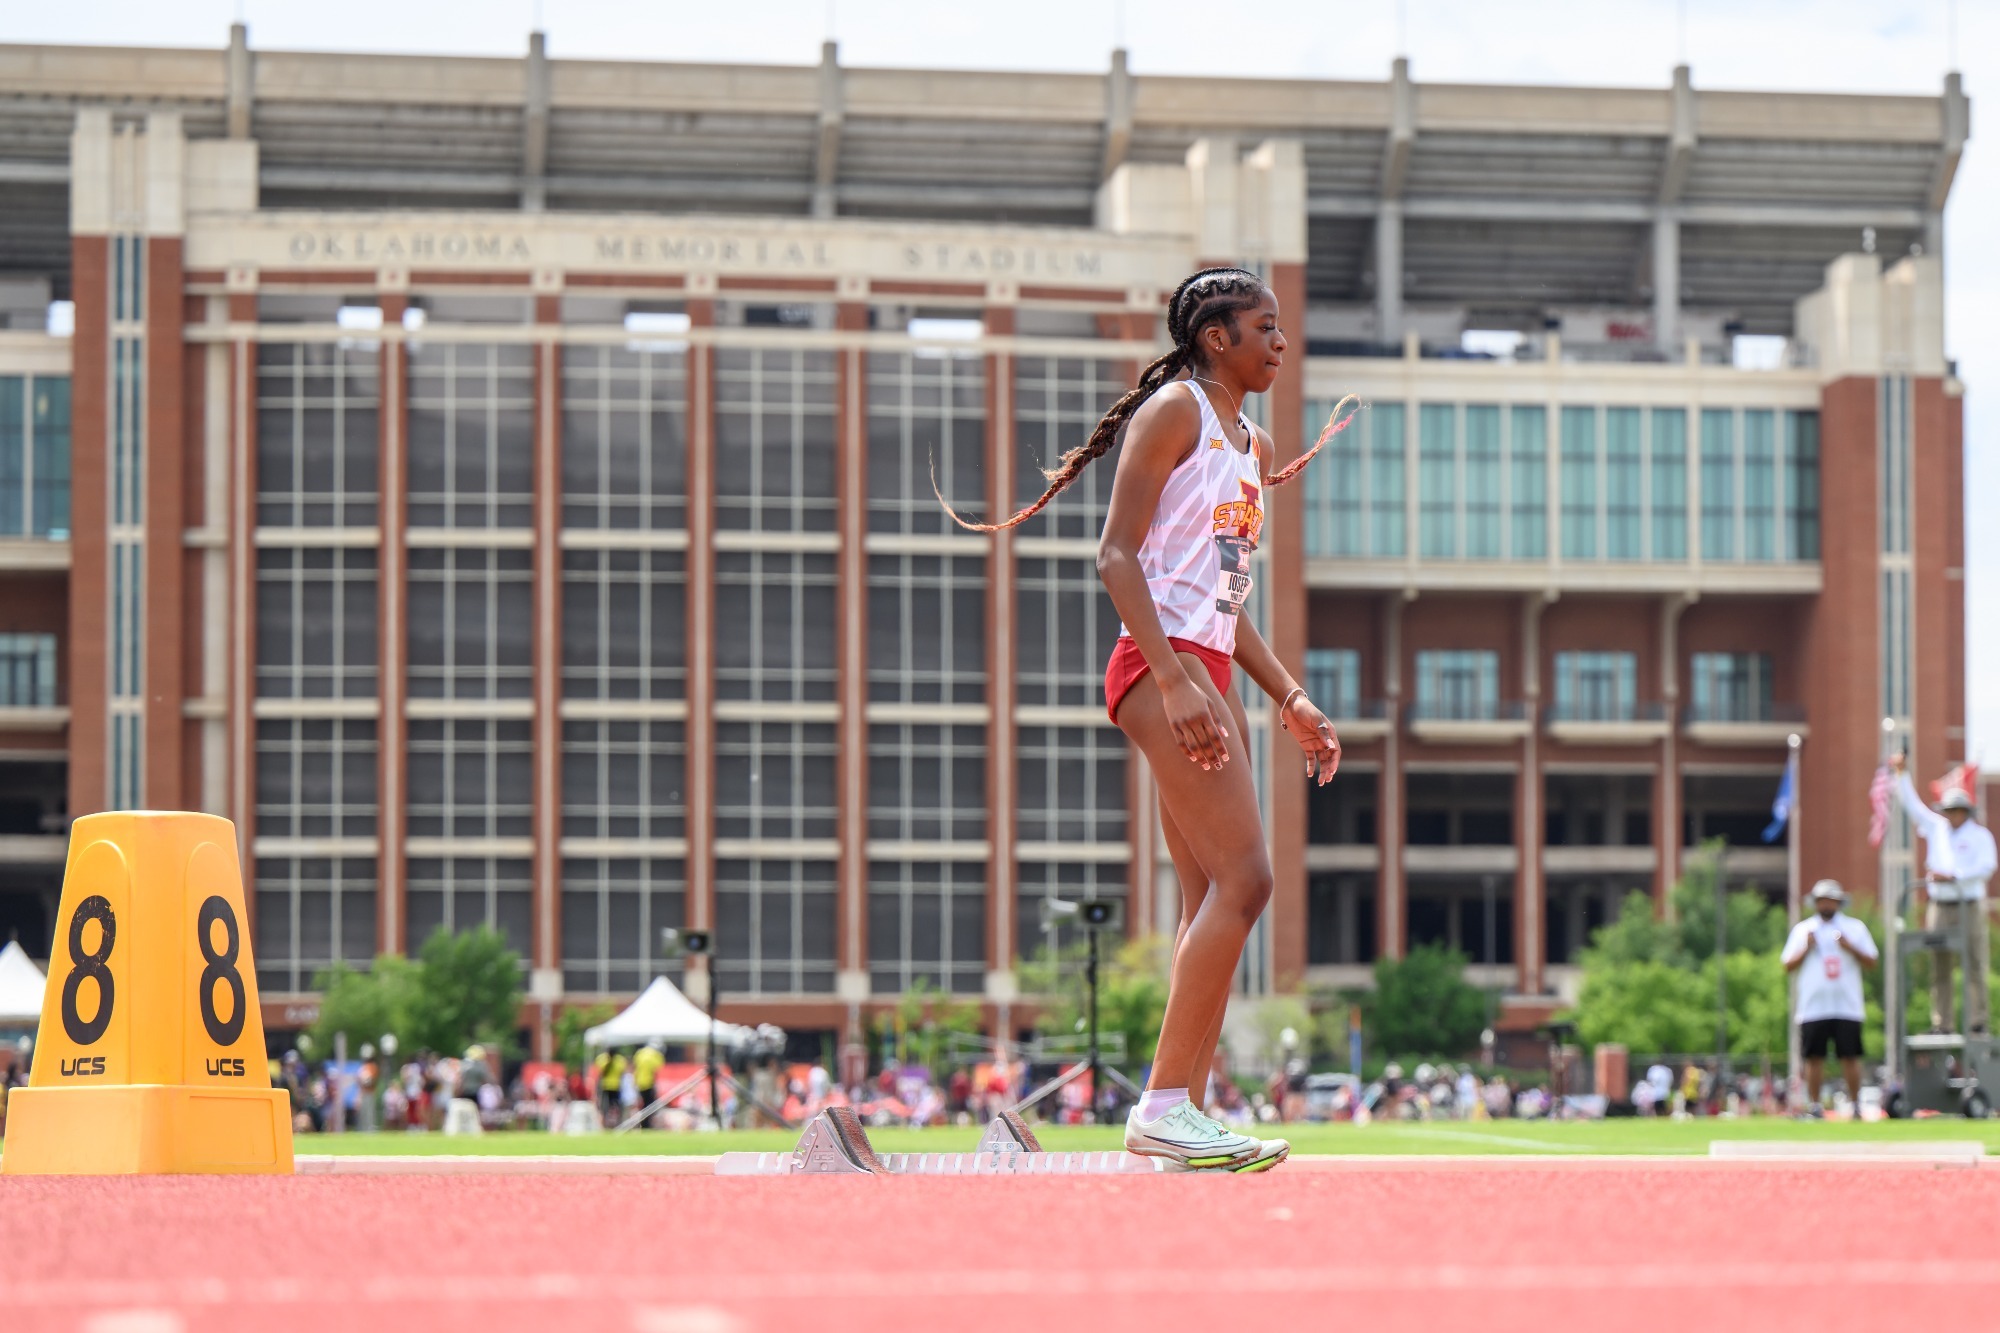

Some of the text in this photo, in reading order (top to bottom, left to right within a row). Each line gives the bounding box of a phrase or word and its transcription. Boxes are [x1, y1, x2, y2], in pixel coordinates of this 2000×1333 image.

[289, 231, 1102, 276] OKLAHOMA MEMORIAL STADIUM
[1213, 501, 1263, 537] STAT
[1228, 573, 1250, 593] JOSEP
[62, 895, 117, 1046] 8
[198, 895, 246, 1047] 8
[60, 1057, 106, 1077] UCS
[206, 1058, 246, 1077] UCS
